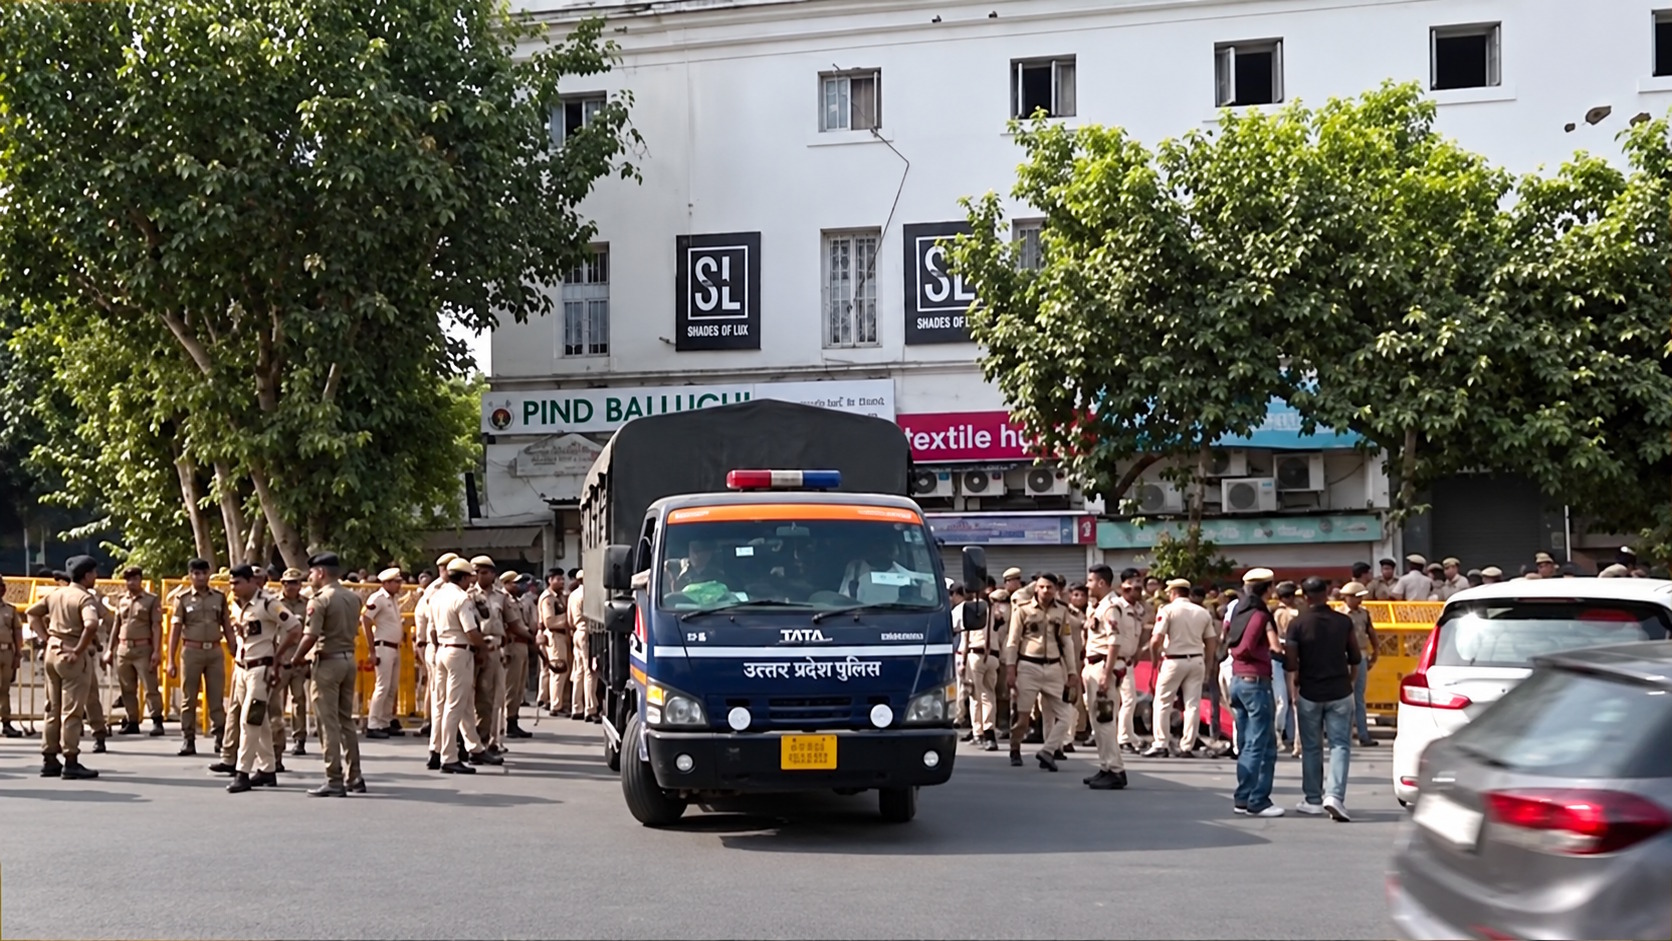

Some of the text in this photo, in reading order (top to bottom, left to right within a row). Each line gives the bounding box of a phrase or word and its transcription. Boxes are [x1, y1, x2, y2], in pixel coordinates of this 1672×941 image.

[694, 256, 741, 311] SL
[925, 245, 976, 302] SL
[687, 324, 749, 337] SHADES OF LUX
[917, 316, 951, 329] SHADES
[953, 316, 964, 328] OF
[523, 398, 594, 425] PIND
[905, 424, 992, 451] textile
[780, 629, 824, 642] TATA
[743, 656, 882, 682] उत्तर प्रदेश पुलिस
